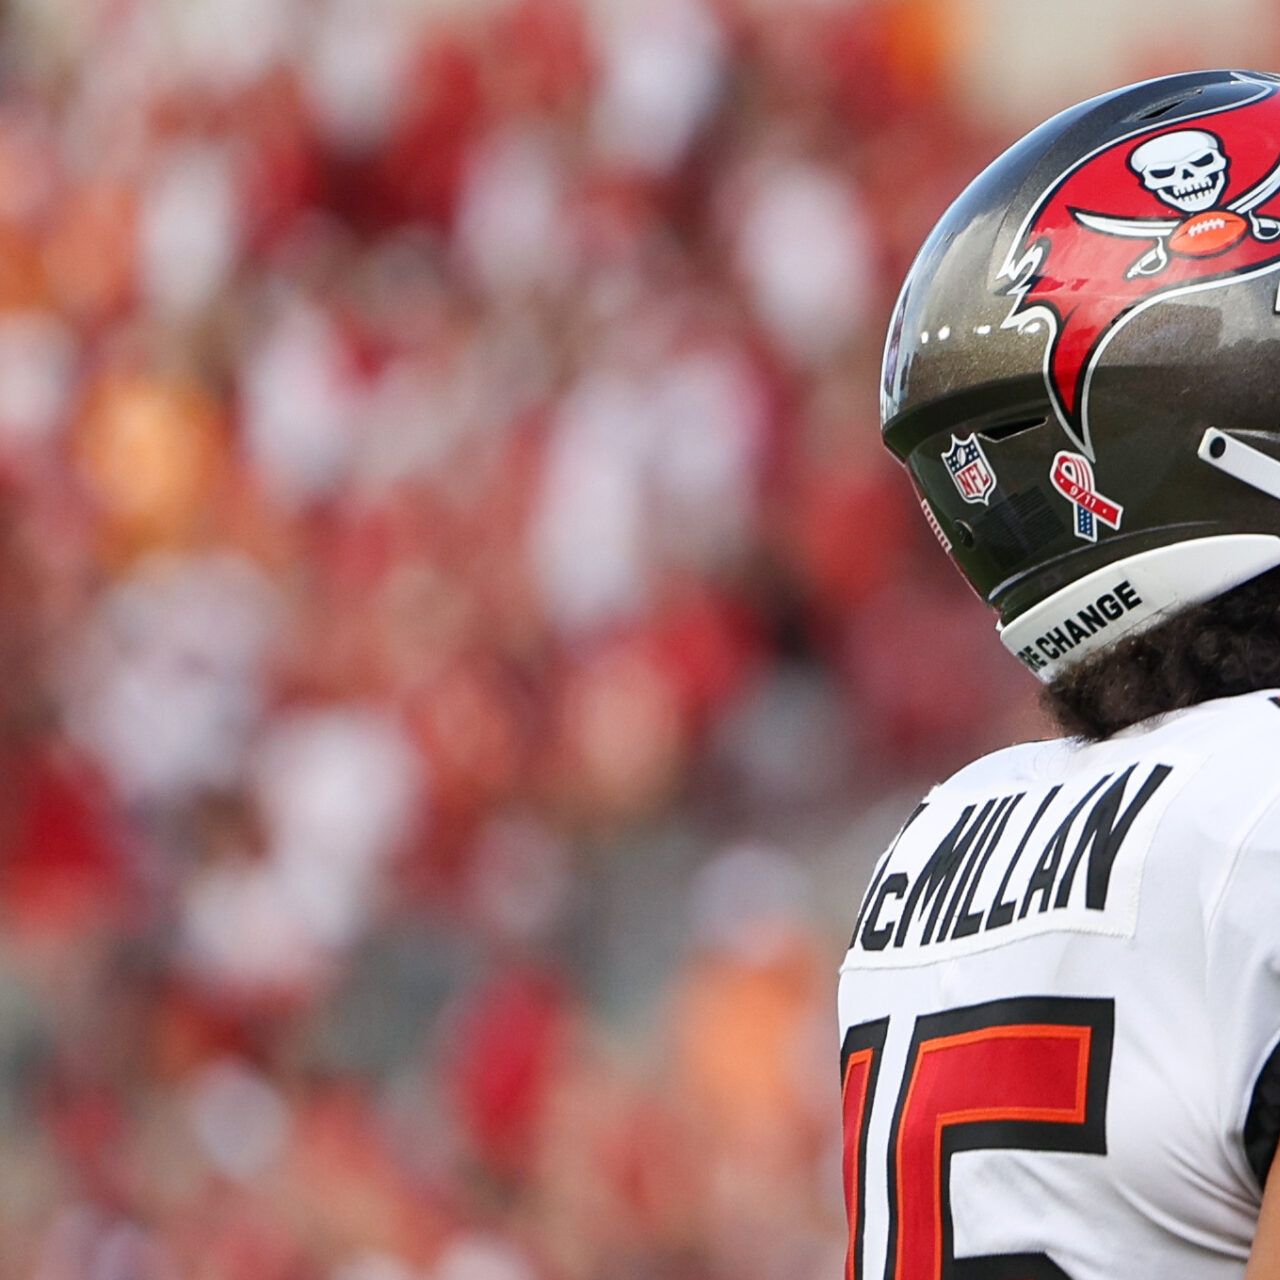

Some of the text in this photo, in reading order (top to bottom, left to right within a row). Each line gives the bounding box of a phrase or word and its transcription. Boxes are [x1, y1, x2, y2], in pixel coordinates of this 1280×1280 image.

[956, 463, 990, 496] NFL
[1070, 485, 1096, 508] 9/11
[1035, 580, 1142, 660] CHANGE
